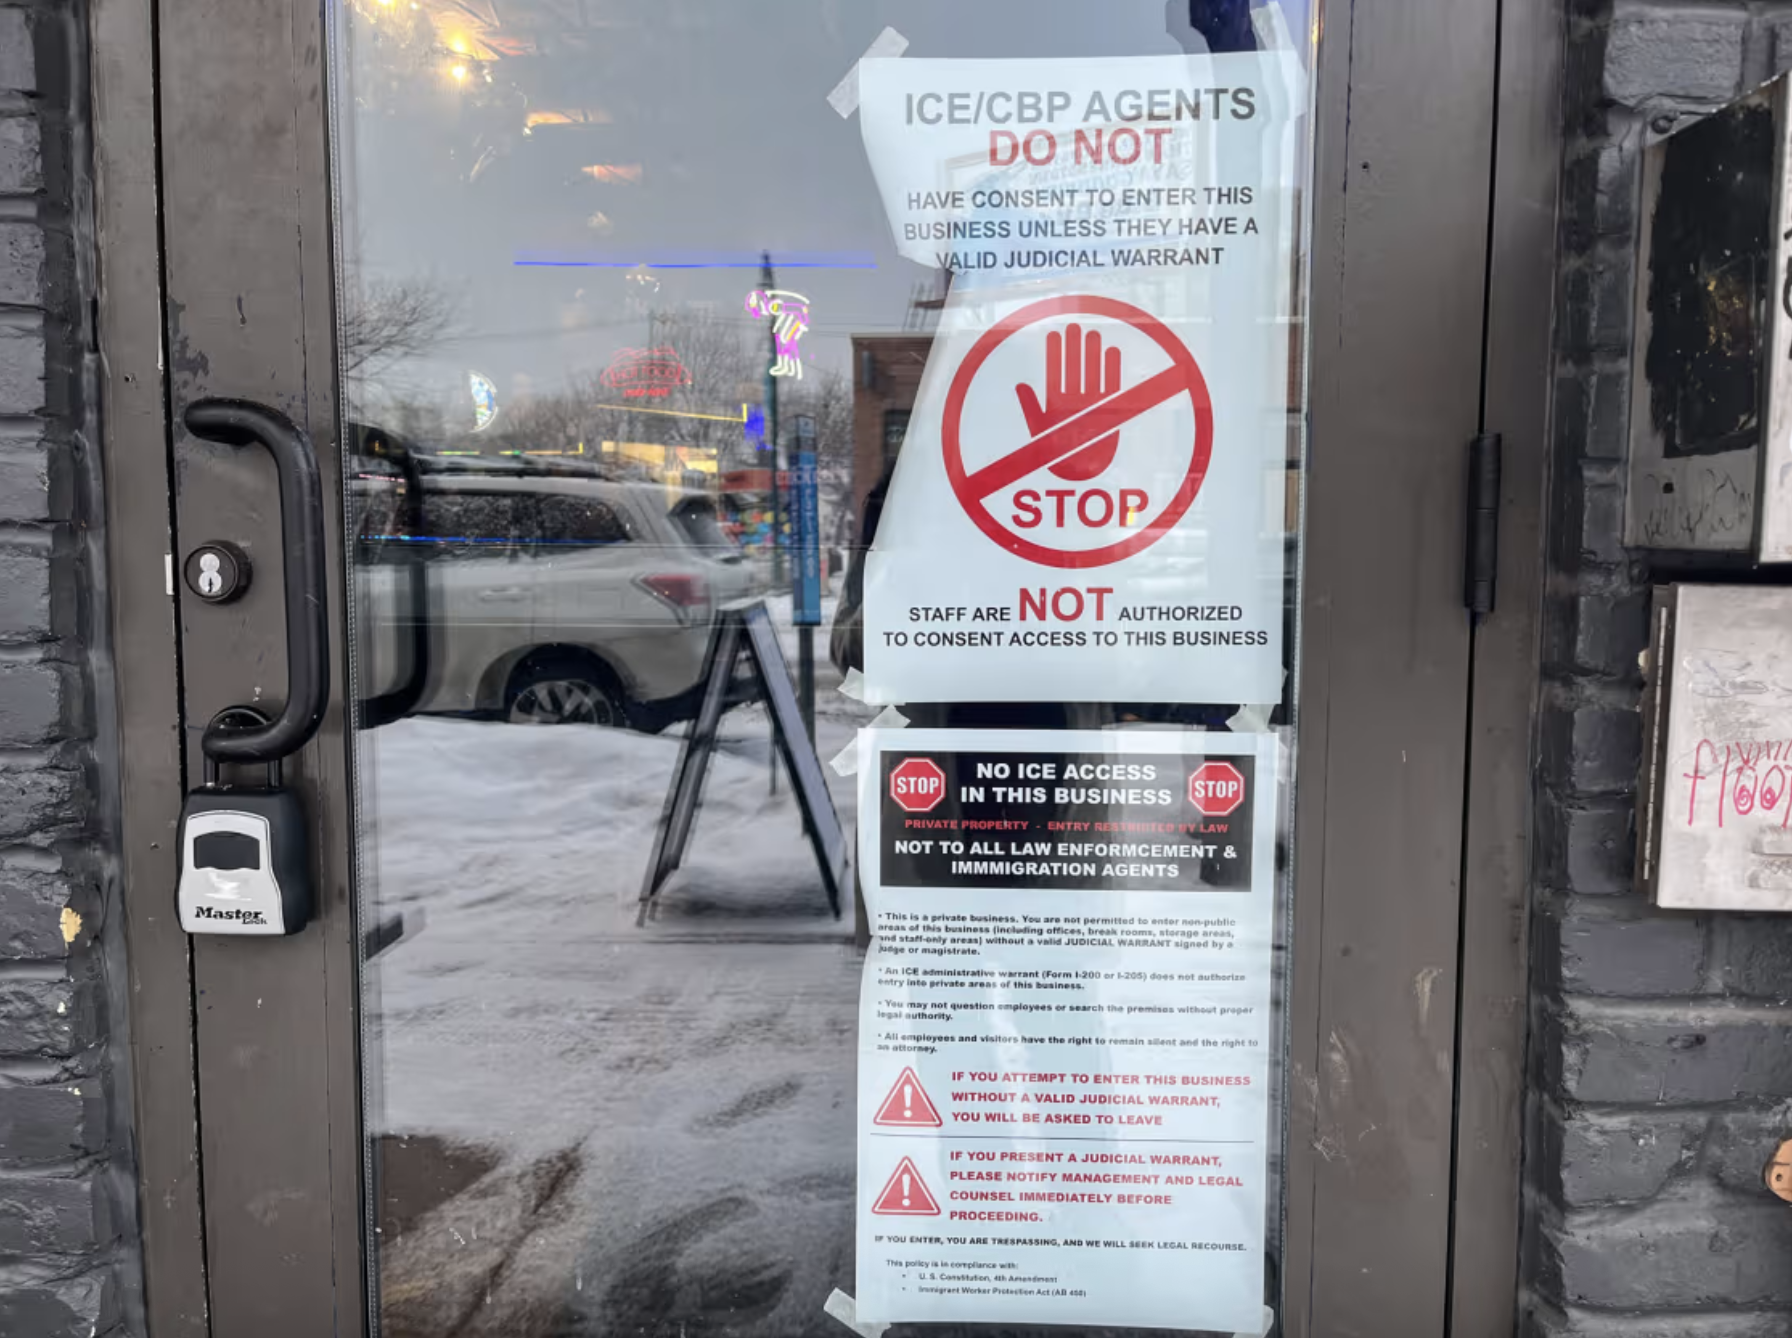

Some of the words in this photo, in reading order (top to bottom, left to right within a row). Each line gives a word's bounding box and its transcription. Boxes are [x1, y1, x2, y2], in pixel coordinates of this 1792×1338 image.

[906, 90, 1070, 125] ICE/CBP
[1083, 87, 1254, 122] AGENTS
[989, 130, 1056, 166] DO
[1075, 127, 1172, 165] NOT
[908, 191, 964, 209] HAVE
[971, 188, 1078, 208] CONSENT
[1085, 188, 1114, 206] TO
[1122, 187, 1195, 206] ENTER
[1203, 186, 1252, 204] THIS
[904, 220, 1010, 240] BUSINESS
[1018, 219, 1106, 238] UNLESS
[1113, 218, 1170, 236] THEY
[1178, 217, 1236, 235] HAVE
[1243, 217, 1258, 234] A
[936, 251, 996, 269] VALID
[1004, 249, 1104, 268] JUDICIAL
[1111, 247, 1224, 266] WARRANT
[1011, 489, 1148, 528] STOP
[909, 606, 966, 621] STAFF
[972, 607, 1010, 621] ARE
[1019, 587, 1112, 621] NOT
[1118, 605, 1242, 620] AUTHORIZED
[883, 631, 907, 646] TO
[913, 631, 1003, 646] CONSENT
[1009, 631, 1086, 646] ACCESS
[1092, 631, 1118, 646] TO
[1124, 631, 1166, 645] THIS
[1172, 631, 1267, 645] BUSINESS
[977, 762, 1010, 778] NO
[1018, 763, 1055, 779] ICE
[1063, 764, 1155, 780] ACCESS
[897, 776, 938, 794] STOP
[1194, 780, 1237, 798] STOP
[961, 786, 984, 802] IN
[992, 786, 1046, 803] THIS
[1054, 787, 1171, 804] BUSINESS
[904, 819, 957, 828] PRIVATE
[961, 820, 1028, 830] PROPERTY
[1047, 821, 1090, 830] ENTRY
[895, 840, 933, 854] NOT
[939, 841, 964, 854] TO
[969, 841, 1004, 855] ALL
[1057, 843, 1217, 857] ENFORMCEMENT
[1223, 845, 1236, 858] &
[952, 860, 1095, 875] IMMMIGRATION
[1102, 863, 1178, 877] AGENTS
[195, 906, 263, 920] Master
[951, 1071, 964, 1081] IF
[969, 1071, 998, 1082] YOU
[1002, 1072, 1066, 1082] ATTEMPT
[1070, 1073, 1089, 1083] TO
[1093, 1073, 1140, 1084] ENTER
[1144, 1074, 1176, 1085] THIS
[1180, 1075, 1250, 1086] BUSINESS
[951, 1091, 1016, 1102] WITHOUT
[1021, 1092, 1030, 1102] A
[1034, 1093, 1076, 1103] VALID
[1079, 1093, 1144, 1105] JUDICIAL
[1147, 1095, 1221, 1109] WARRANT,
[952, 1111, 980, 1122] YOU
[984, 1112, 1016, 1122] WILL
[1022, 1112, 1040, 1123] BE
[1044, 1113, 1091, 1124] ASKED
[1095, 1114, 1114, 1124] TO
[1118, 1114, 1162, 1125] LEAVE
[950, 1150, 962, 1160] IF
[967, 1151, 996, 1161] YOU
[999, 1151, 1063, 1162] PRESENT
[1067, 1152, 1077, 1162] A
[1081, 1152, 1144, 1164] JUDICIAL
[1149, 1154, 1223, 1168] WARRANT,
[949, 1170, 1002, 1181] PLEASE
[1006, 1171, 1057, 1182] NOTIFY
[1061, 1172, 1160, 1184] MANAGEMENT
[1165, 1175, 1194, 1185] AND
[1198, 1175, 1243, 1186] LEGAL
[949, 1190, 1013, 1201] COUNSEL
[1019, 1191, 1112, 1203] IMMEDIATELY
[1116, 1193, 1170, 1204] BEFORE
[949, 1210, 1044, 1221] PROCEEDING.
[886, 1235, 906, 1243] YOU
[909, 1236, 943, 1244] ENTER,
[946, 1236, 966, 1244] YOU
[991, 1237, 1060, 1246] TRESPASSING,
[1085, 1239, 1100, 1247] WE
[1157, 1241, 1188, 1249] LEGAL
[1191, 1242, 1246, 1251] RECOURSE.
